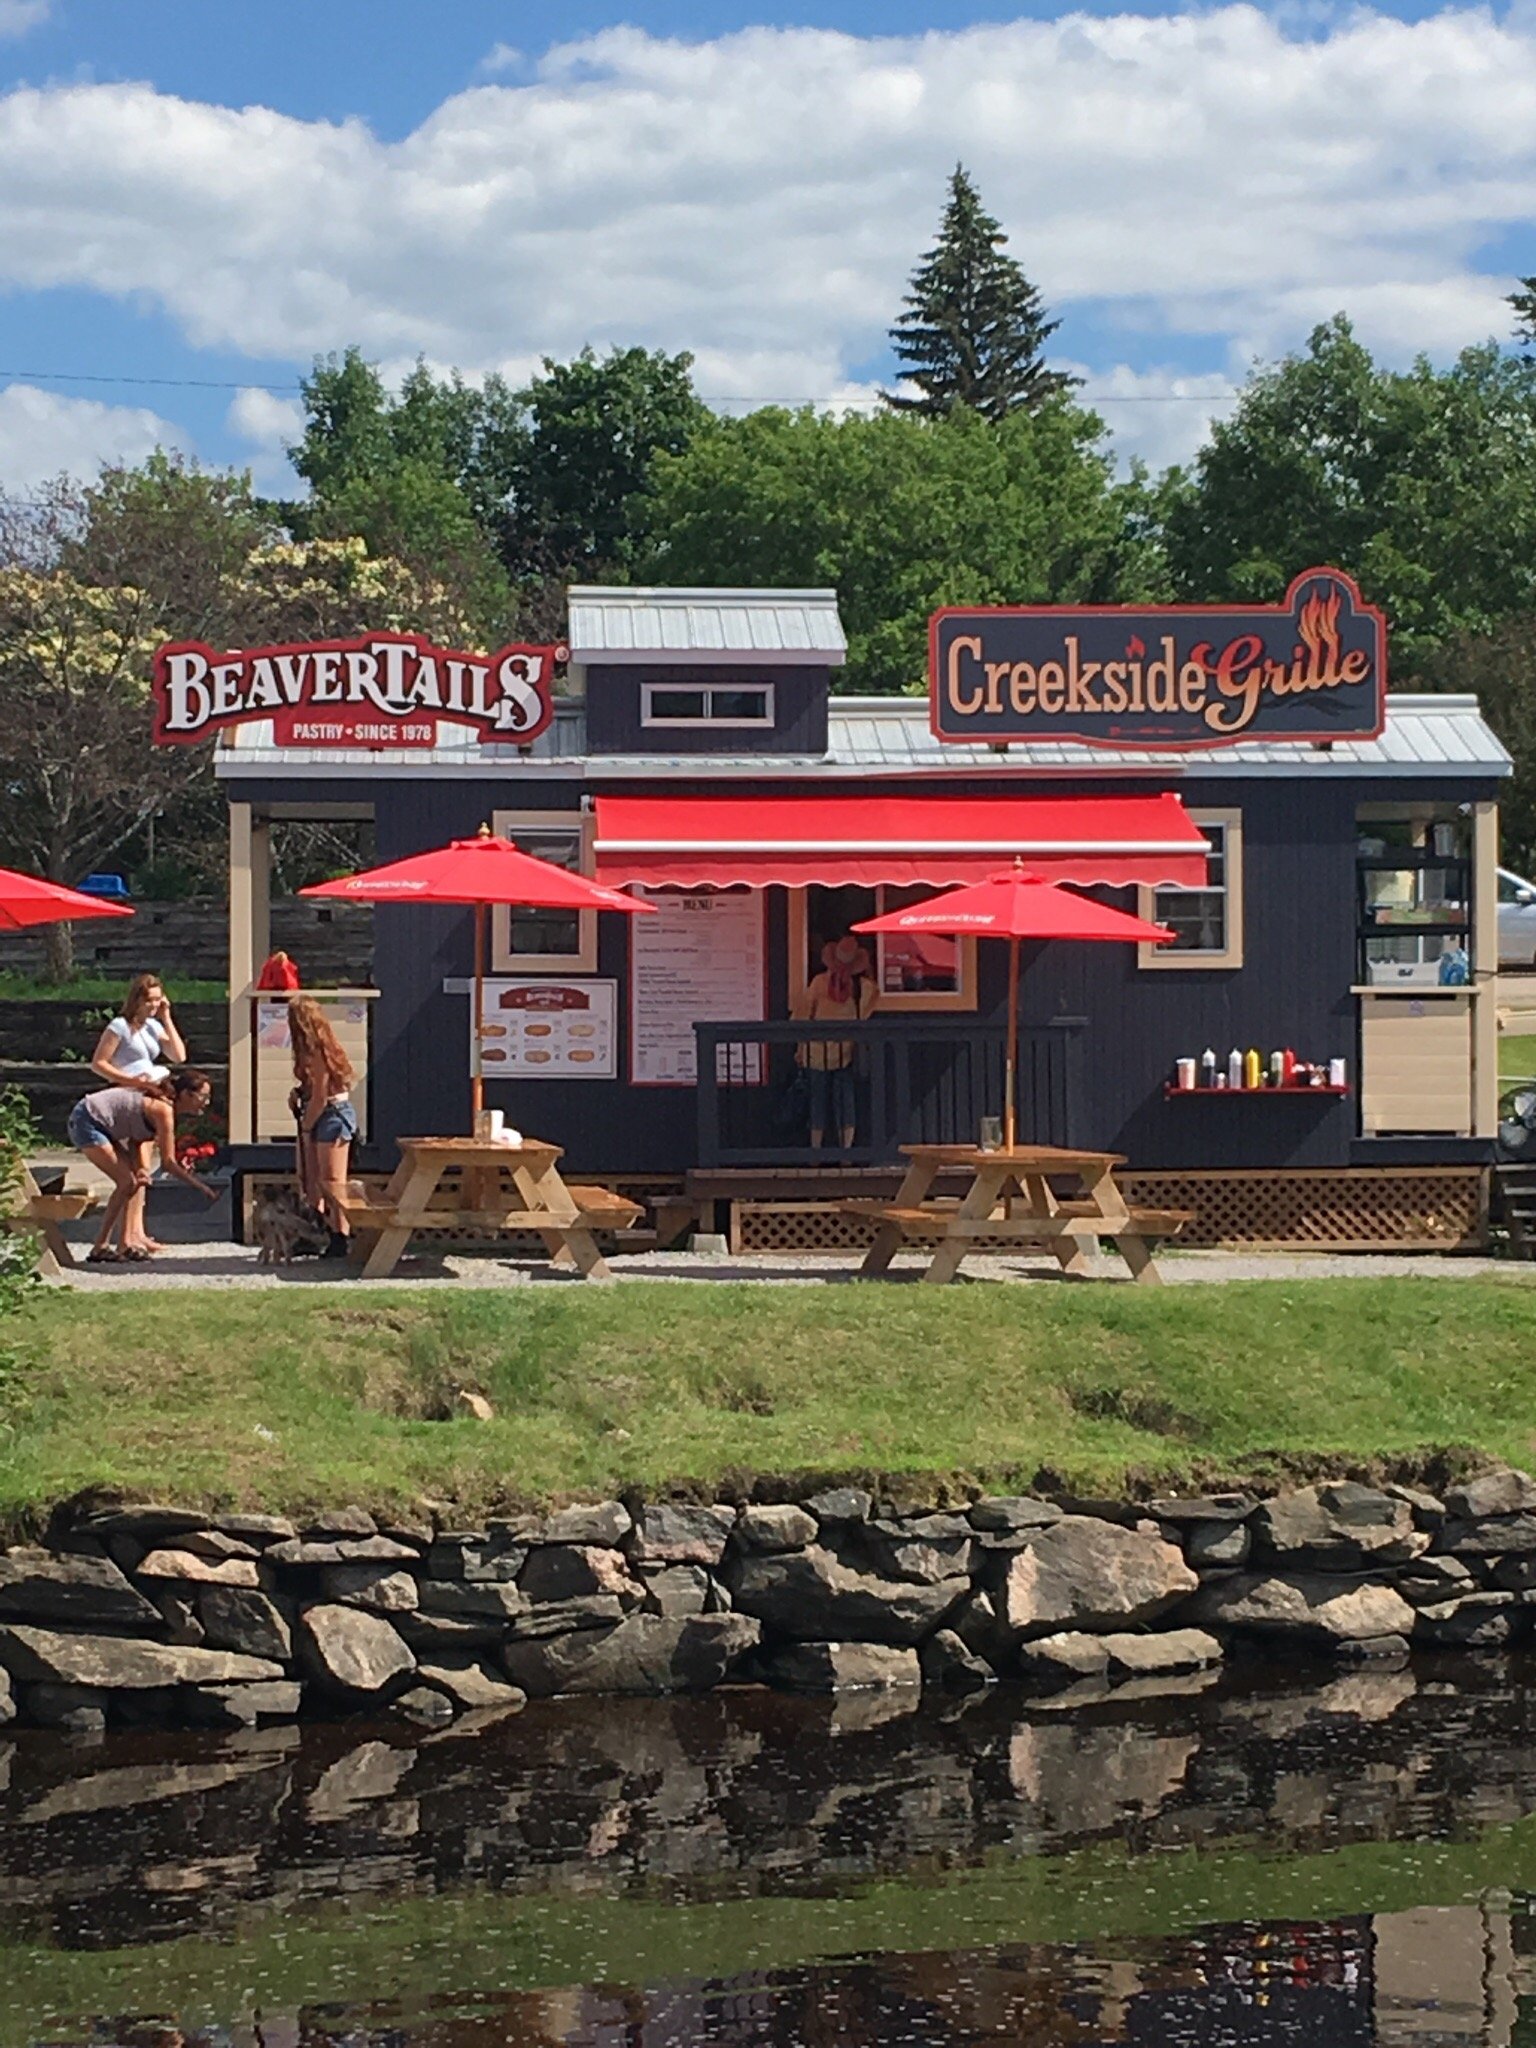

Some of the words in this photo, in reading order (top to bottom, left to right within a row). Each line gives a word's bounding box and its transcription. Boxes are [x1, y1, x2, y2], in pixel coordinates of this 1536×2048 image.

[166, 642, 543, 733] BEAVERTAILS
[947, 635, 1206, 715] Creekside
[1190, 581, 1370, 732] Grille
[293, 723, 344, 740] PASTRY
[354, 724, 398, 741] SINCE
[401, 724, 432, 741] 1978
